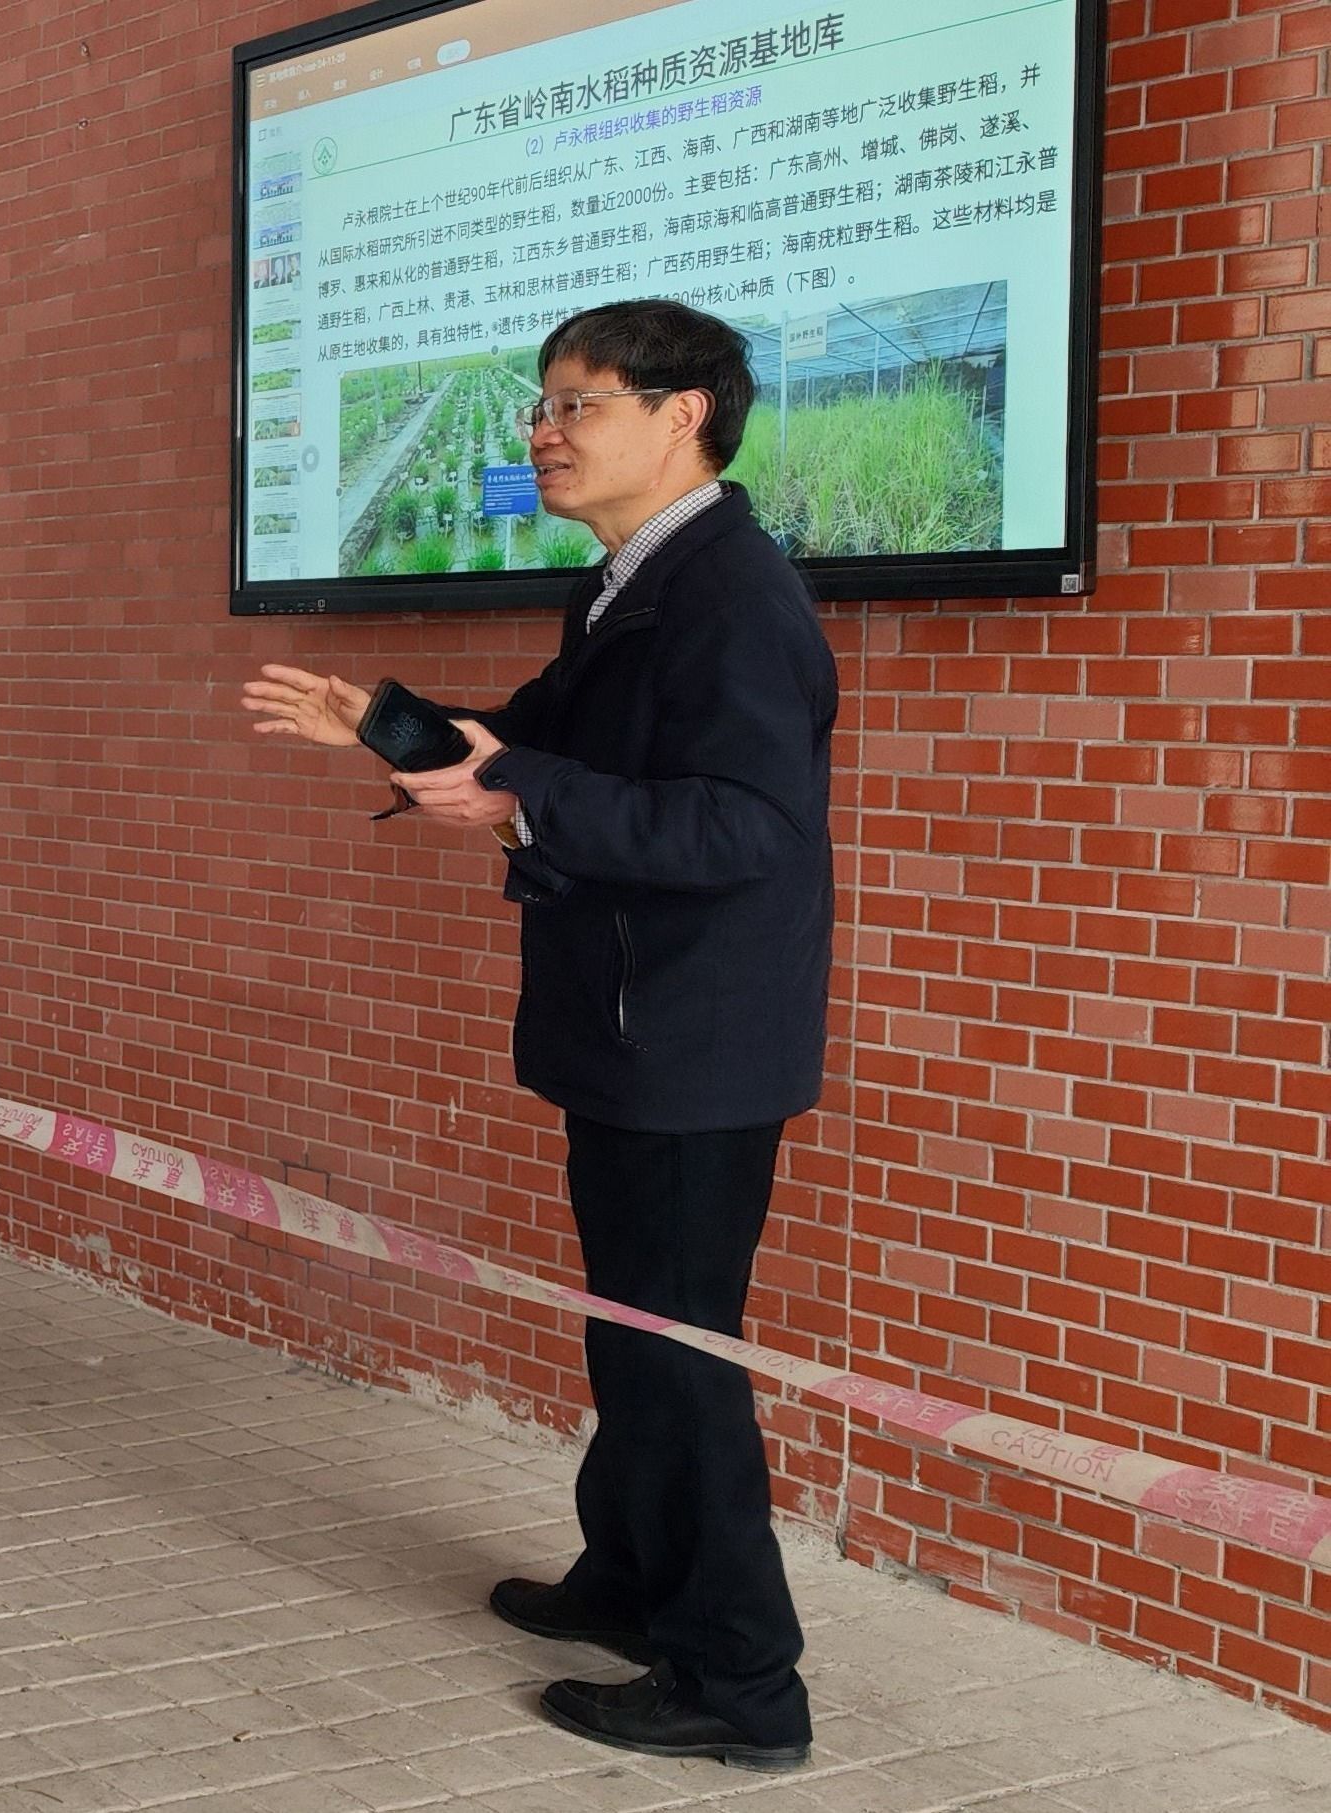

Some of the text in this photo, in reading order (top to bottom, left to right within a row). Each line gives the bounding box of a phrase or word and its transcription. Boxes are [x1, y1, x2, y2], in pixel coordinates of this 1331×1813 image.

[448, 12, 846, 142] 广东省岭南水稻种质资源基地库
[703, 1333, 808, 1375] CAUTION
[844, 1382, 941, 1423] SAFE
[990, 1429, 1116, 1482] CAUTION
[1175, 1487, 1292, 1542] SAFE
